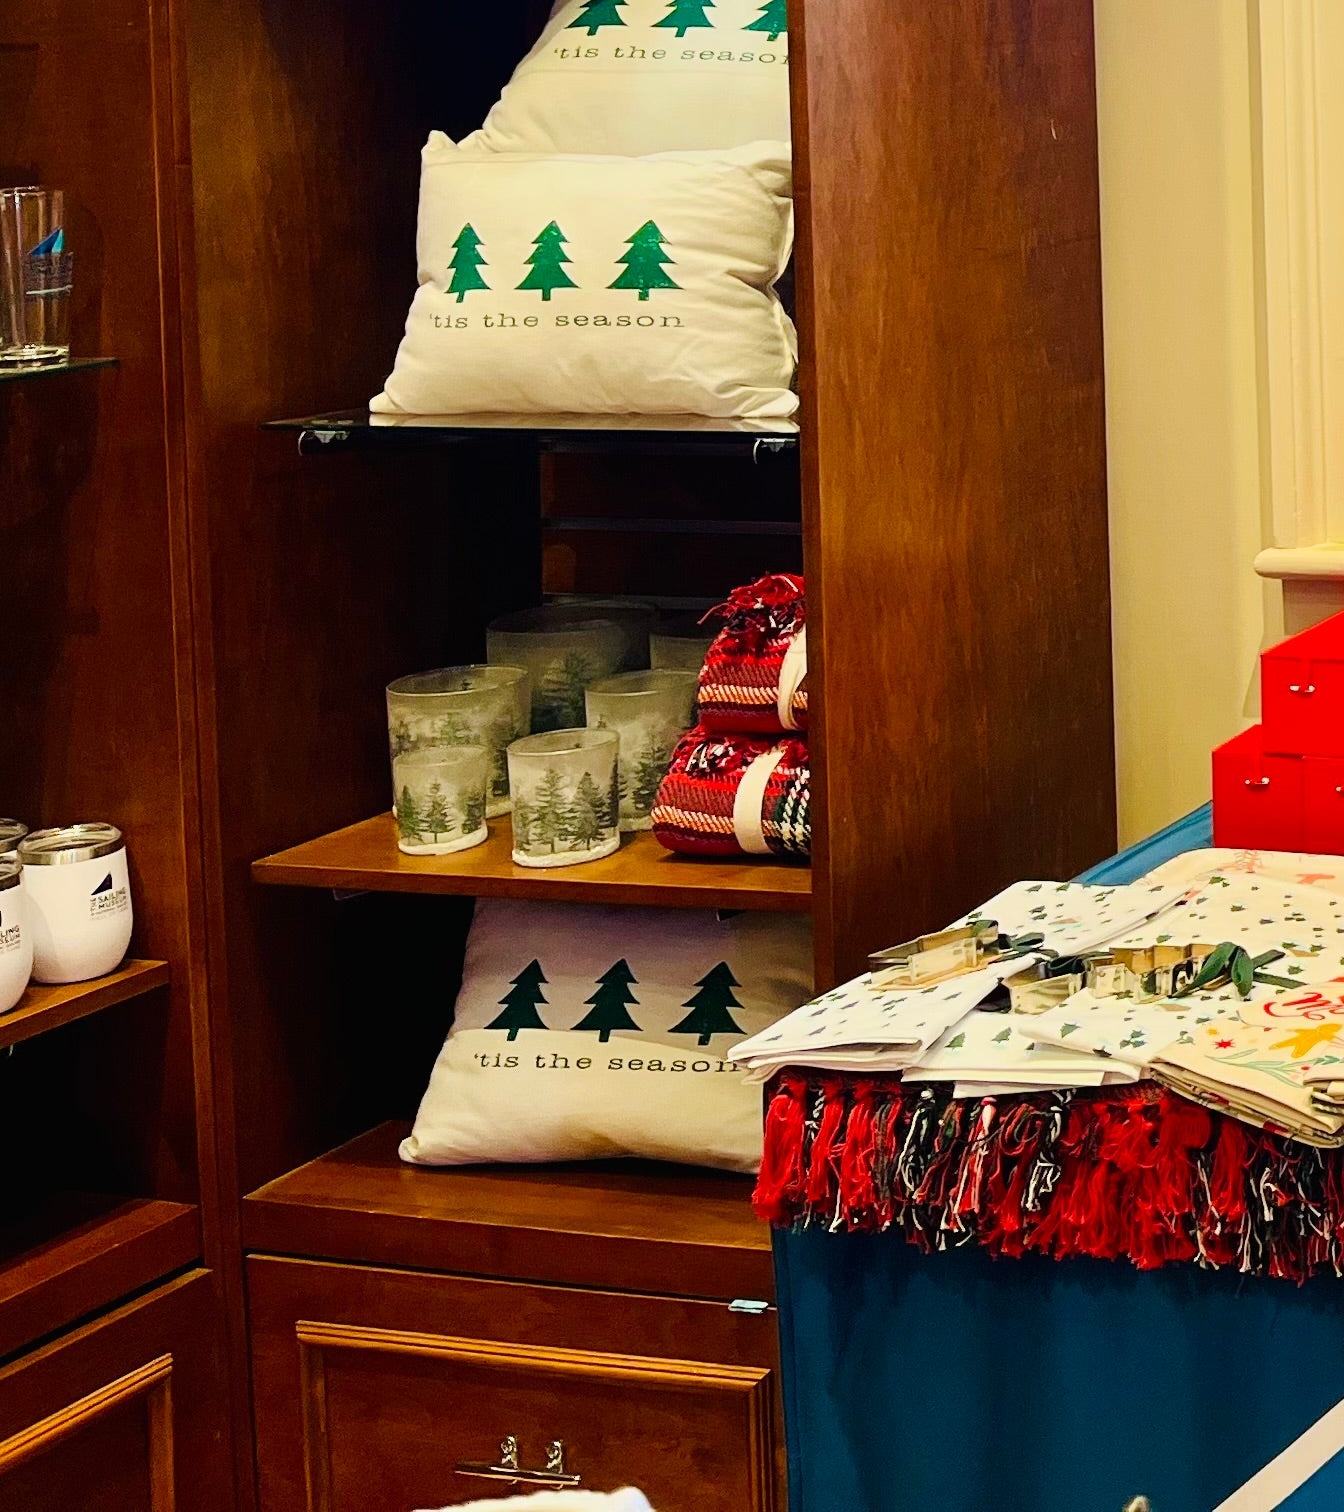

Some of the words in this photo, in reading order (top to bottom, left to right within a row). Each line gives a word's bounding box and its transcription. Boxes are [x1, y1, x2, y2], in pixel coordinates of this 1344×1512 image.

[613, 45, 667, 60] the
[483, 313, 539, 328] the
[555, 314, 686, 328] season
[535, 1052, 592, 1070] the
[607, 1056, 742, 1073] season
